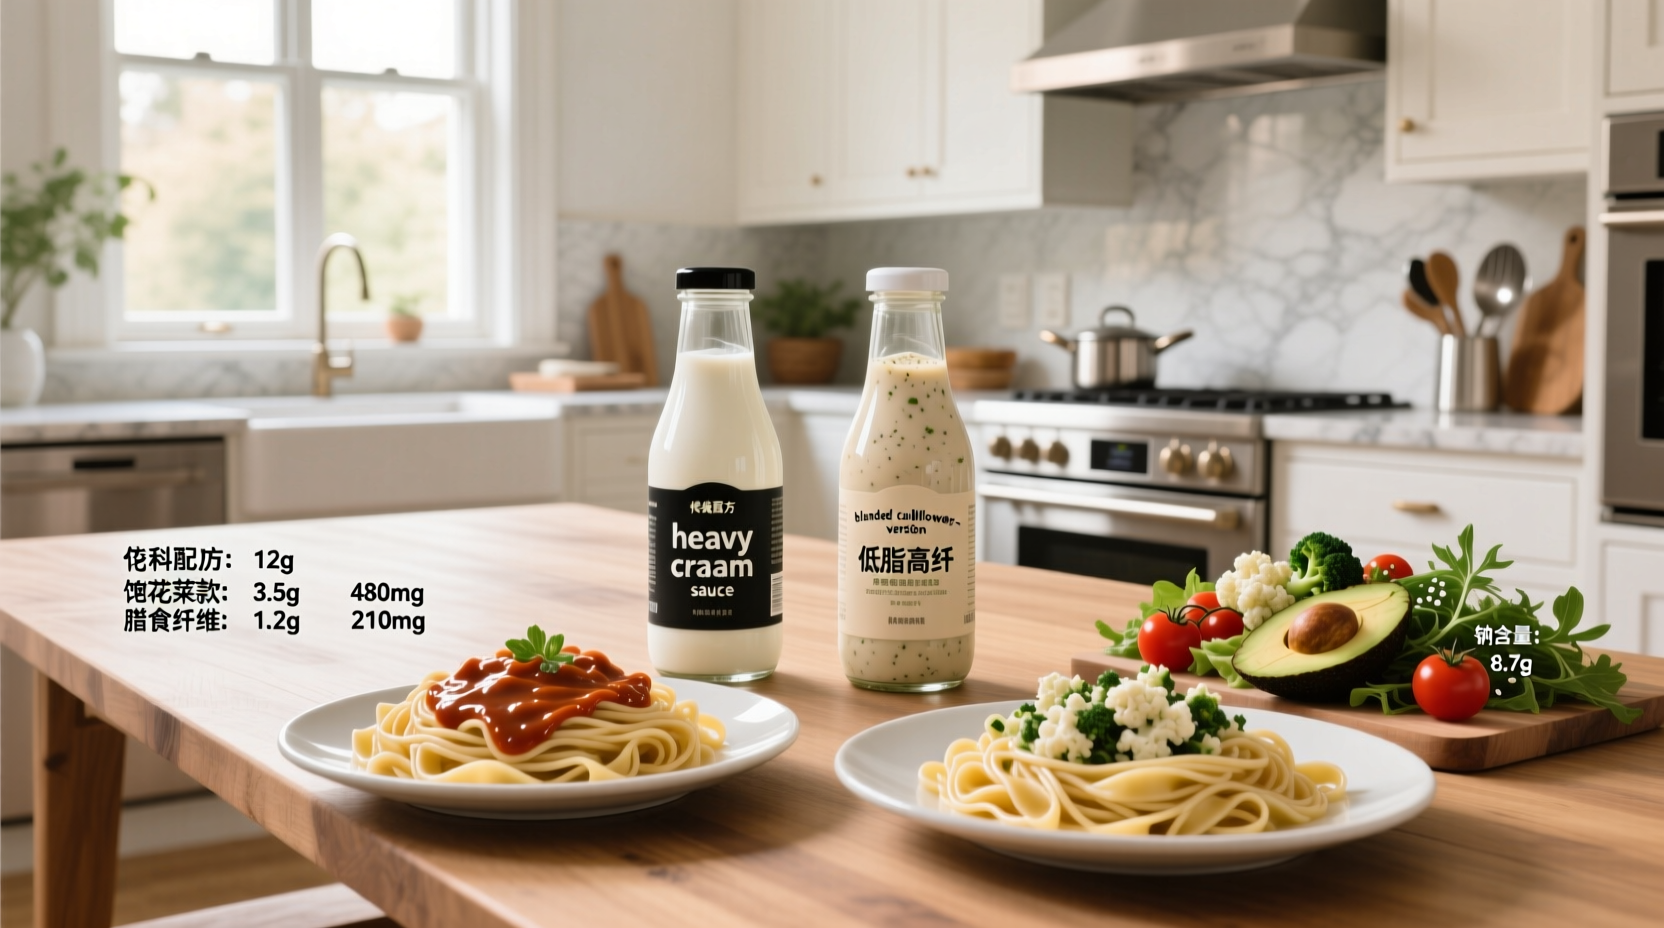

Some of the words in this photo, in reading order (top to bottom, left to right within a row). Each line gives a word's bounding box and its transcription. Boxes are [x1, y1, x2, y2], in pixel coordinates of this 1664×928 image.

[672, 521, 754, 556] heavy
[670, 558, 754, 578] craam
[858, 545, 955, 574] 低脂高纤
[690, 585, 735, 597] sauce
